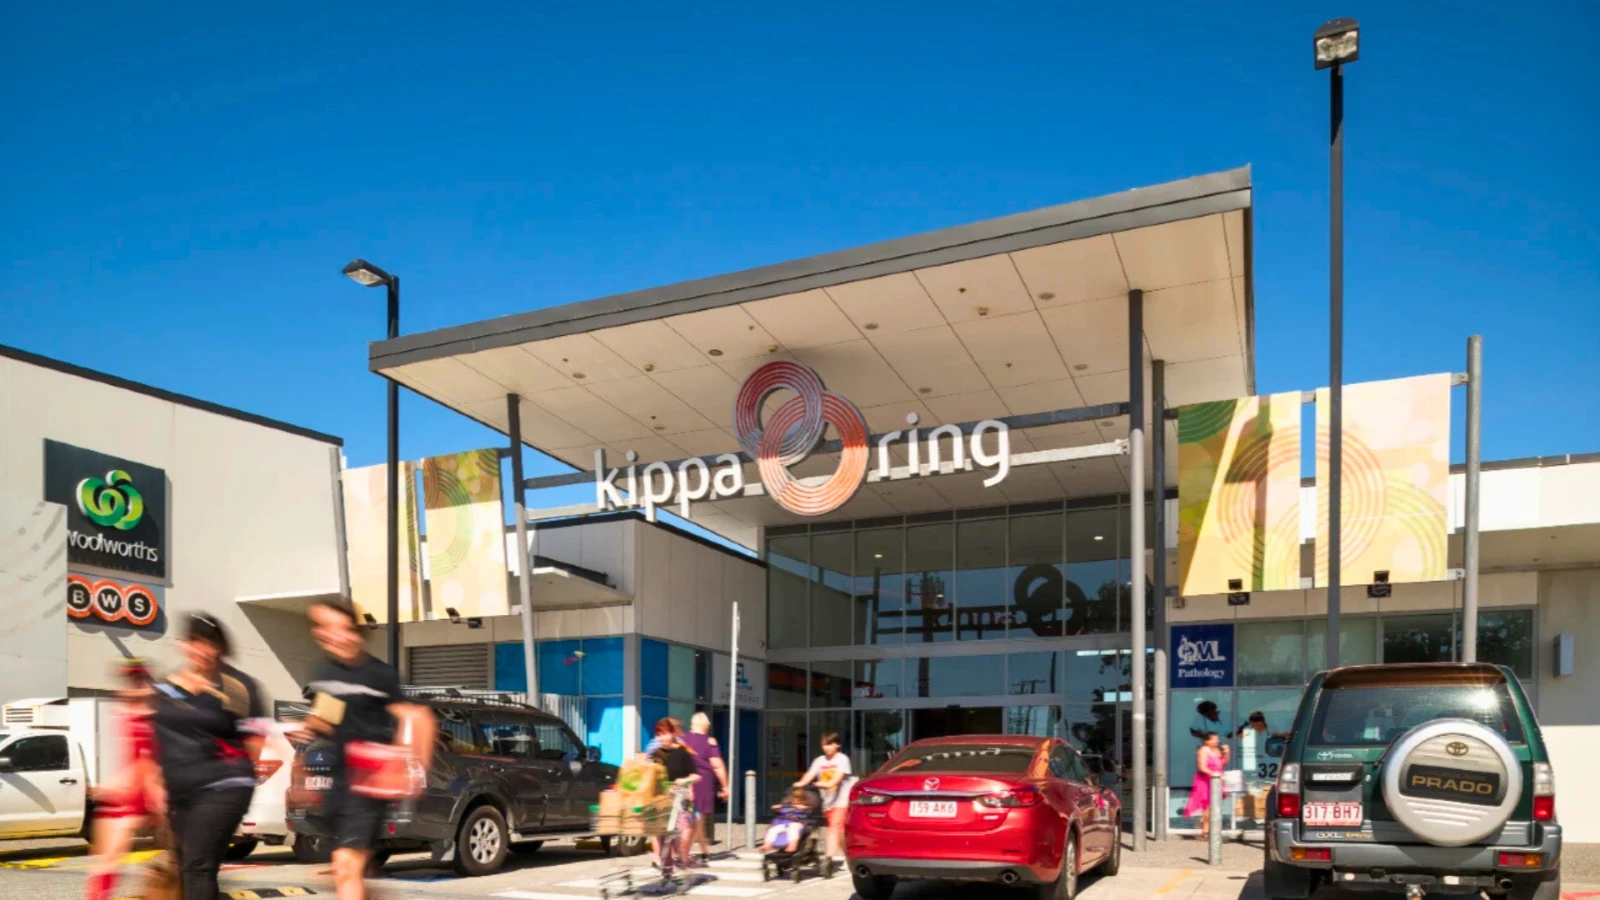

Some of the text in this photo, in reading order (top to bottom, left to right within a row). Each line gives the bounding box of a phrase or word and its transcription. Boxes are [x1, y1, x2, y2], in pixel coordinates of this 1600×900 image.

[594, 412, 1011, 522] kippa ring
[1178, 668, 1225, 679] Pathology
[1411, 775, 1493, 794] PRADO
[1304, 806, 1360, 819] 317 BH7
